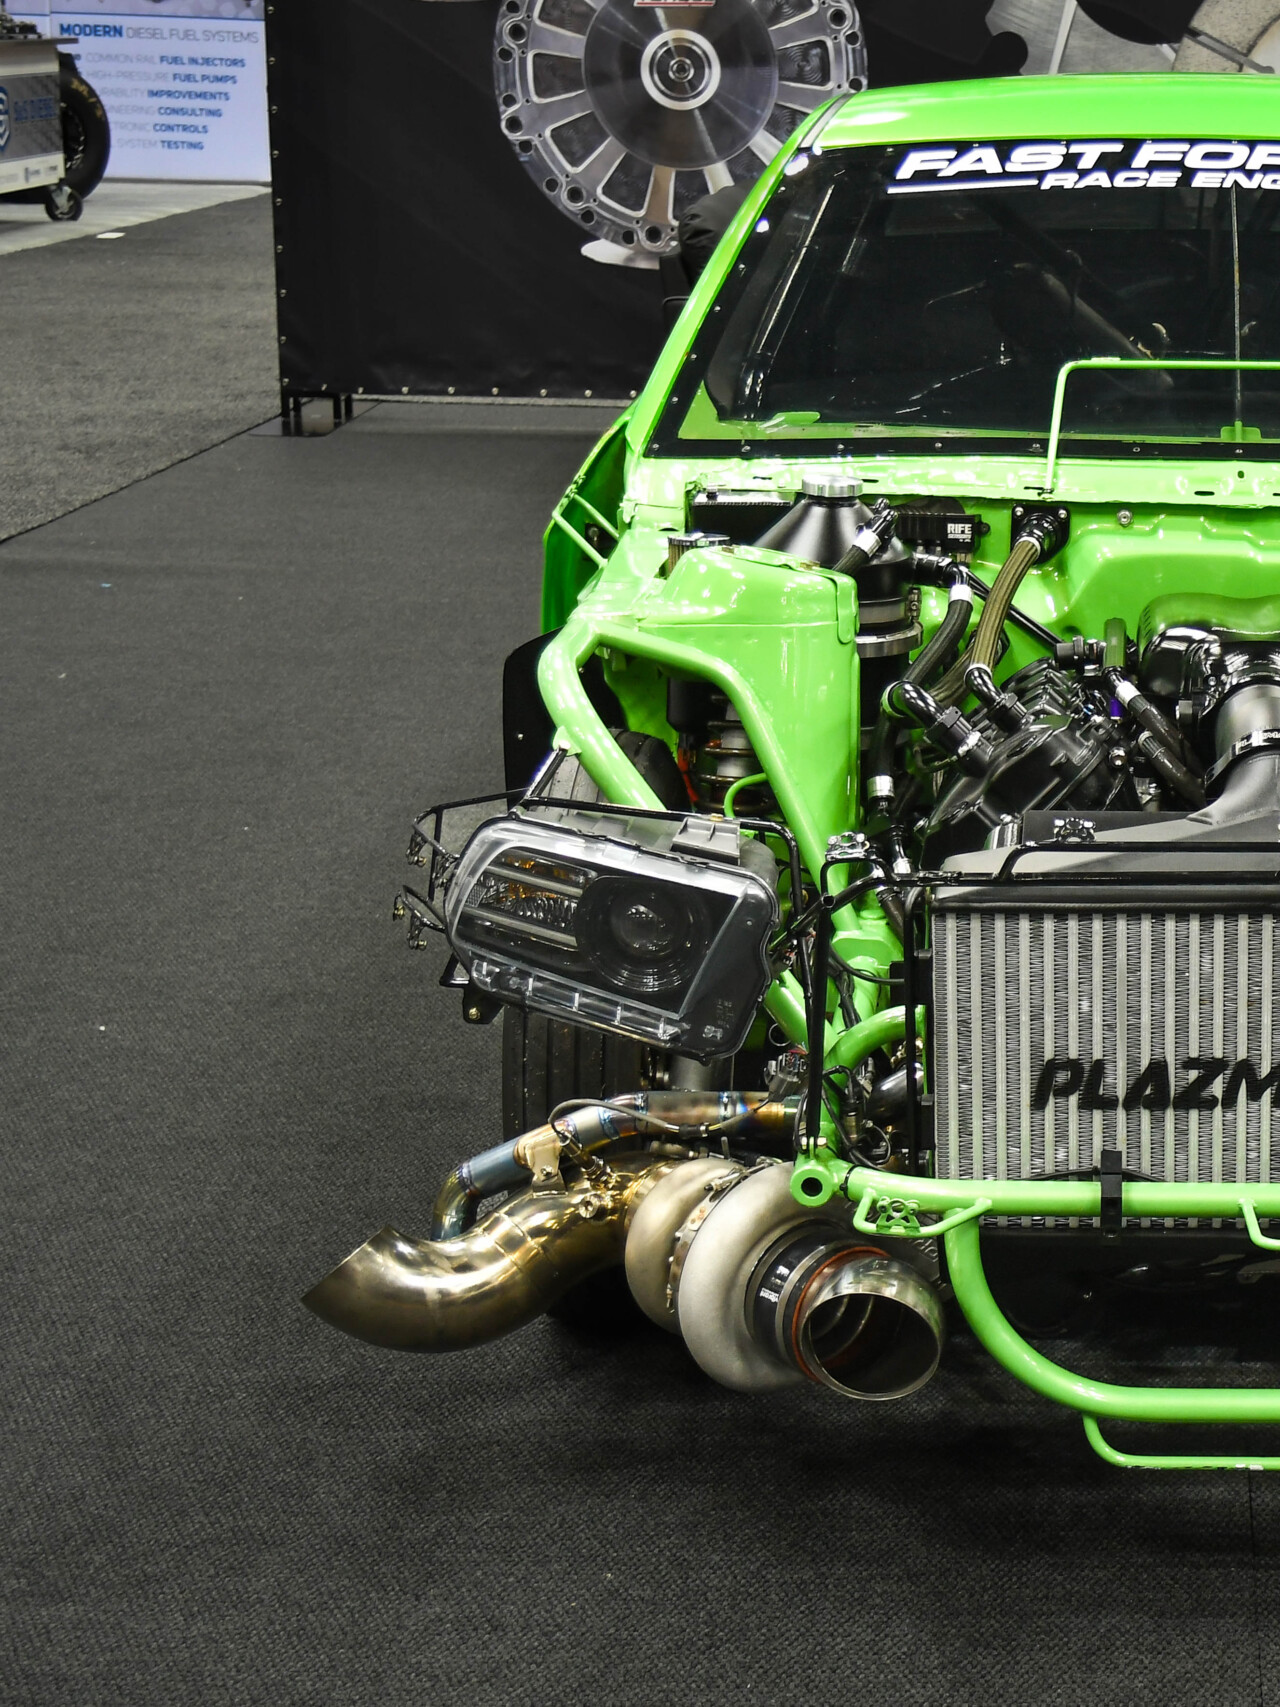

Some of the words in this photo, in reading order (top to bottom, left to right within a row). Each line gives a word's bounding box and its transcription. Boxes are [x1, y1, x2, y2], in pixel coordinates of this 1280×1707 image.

[59, 23, 123, 38] MODERN
[126, 26, 166, 40] DIESEL
[169, 27, 200, 41] FUEL
[202, 29, 259, 43] SYSTEMS
[160, 55, 185, 66] FUEL
[187, 56, 246, 68] INJECTORS
[173, 72, 199, 83] FUEL
[200, 74, 238, 85] PUMPS
[147, 89, 230, 101] IMPROVEMENTS
[157, 106, 223, 118] CONSULTING
[152, 122, 209, 134] CONTROLS
[160, 139, 205, 151] TESTING
[895, 142, 1125, 181] FAST
[1039, 171, 1183, 190] RACE
[947, 523, 973, 534] RIFE
